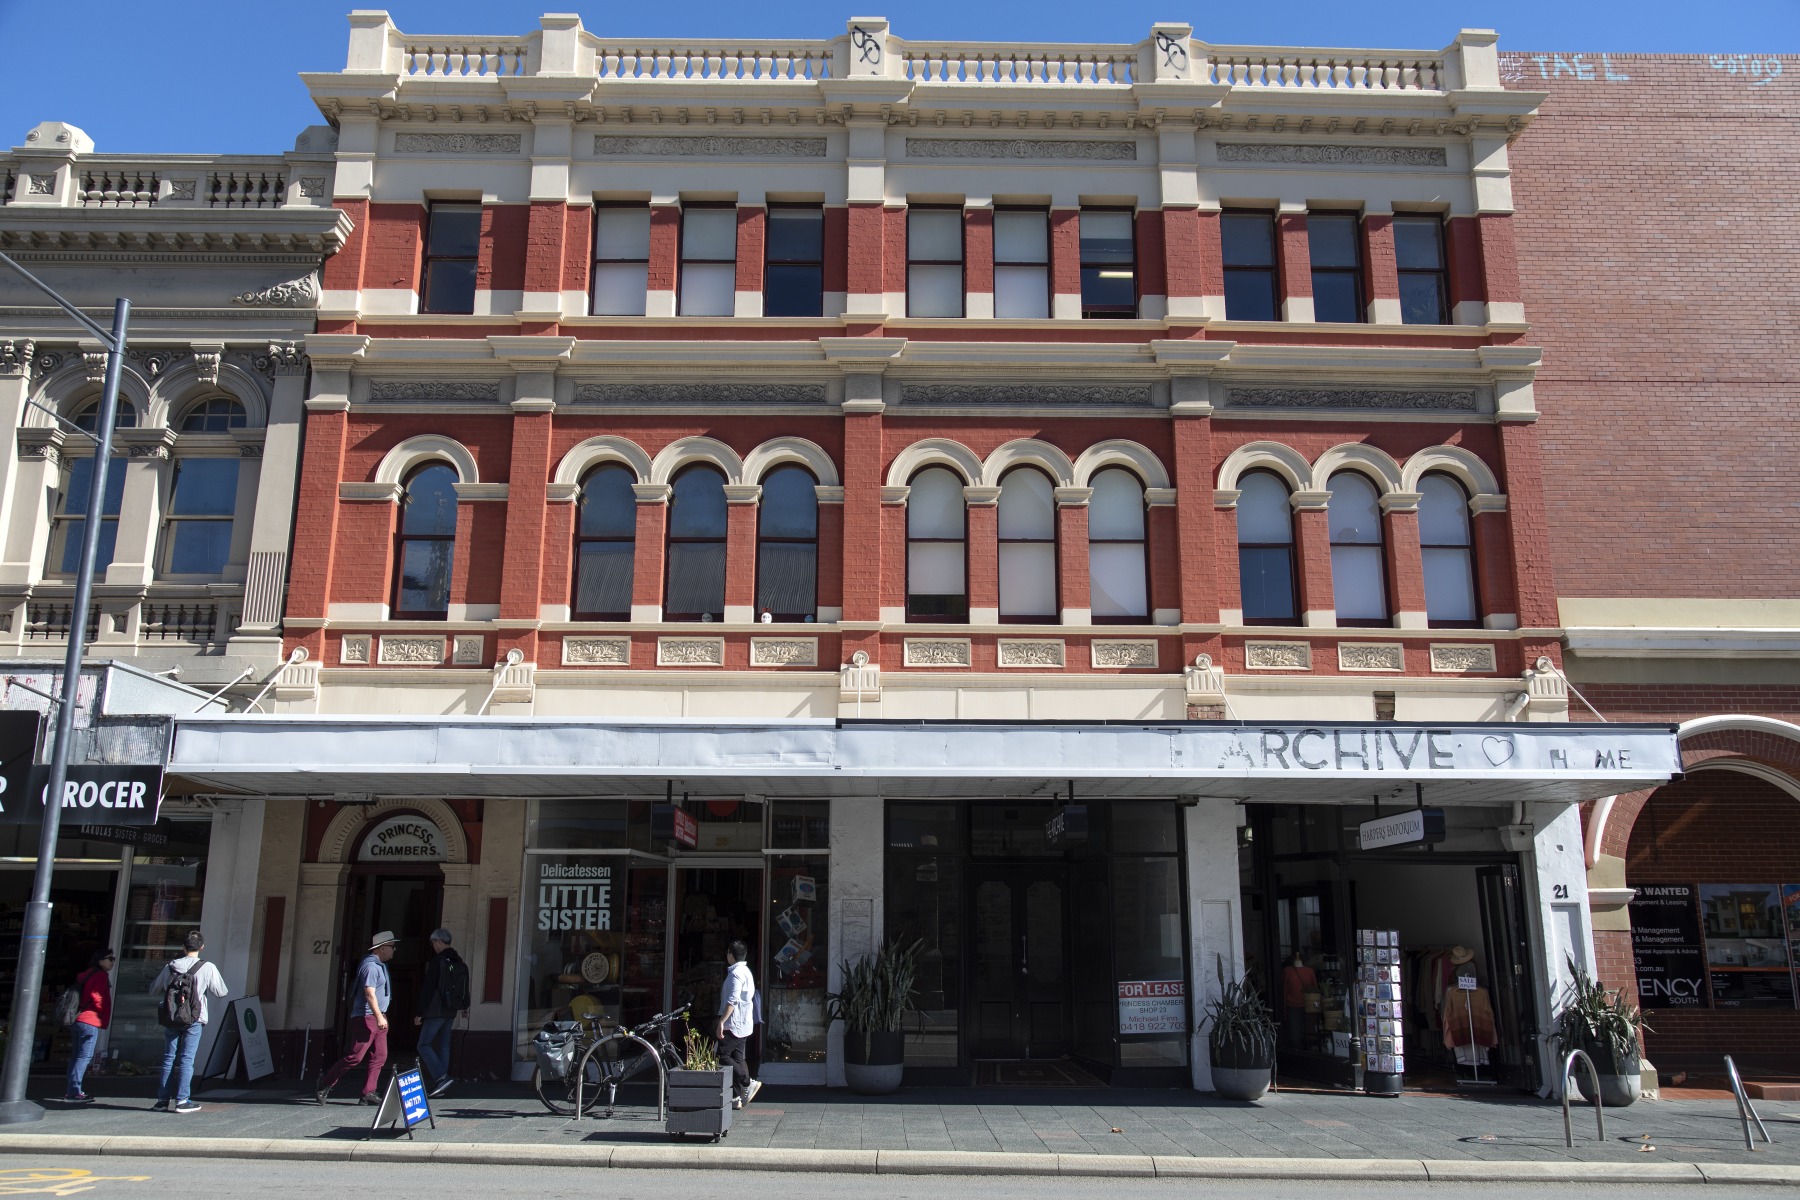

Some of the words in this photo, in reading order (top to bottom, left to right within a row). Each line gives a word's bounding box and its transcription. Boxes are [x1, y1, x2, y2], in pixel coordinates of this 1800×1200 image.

[143, 832, 168, 844] GROCER
[377, 823, 434, 844] PRINCESS
[540, 863, 611, 877] Delicatessen
[539, 885, 611, 908] LITTLE
[1553, 884, 1569, 899] 21
[1644, 887, 1690, 896] WANTED
[1666, 899, 1687, 907] Leasing
[537, 909, 611, 931] SISTER
[1637, 926, 1680, 935] Management
[1635, 935, 1641, 943] &
[1641, 935, 1685, 944] Management
[313, 940, 330, 954] 27
[1118, 984, 1144, 997] FOR
[1147, 983, 1185, 996] LEASE
[1639, 978, 1703, 997] ENCY
[1128, 1015, 1159, 1023] Michael
[1120, 1023, 1145, 1031] 0418
[1147, 1022, 1166, 1030] 922
